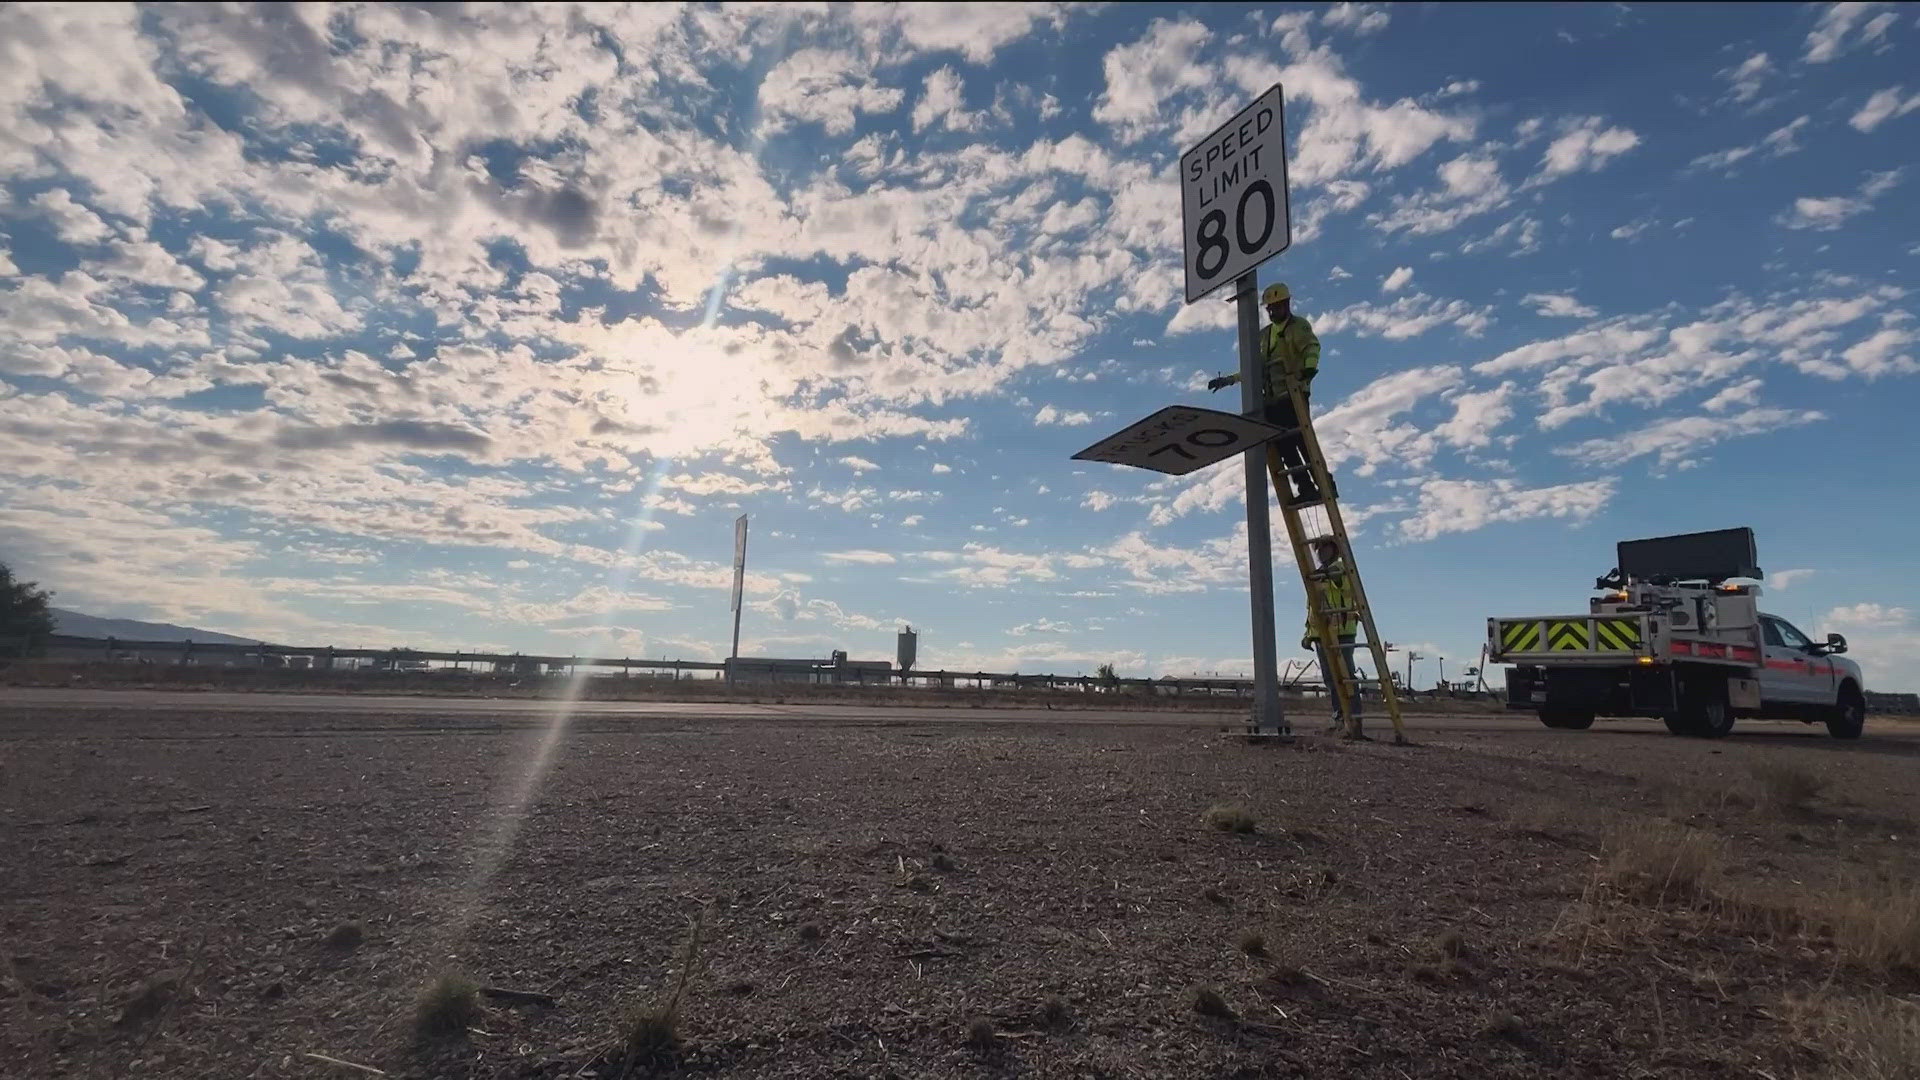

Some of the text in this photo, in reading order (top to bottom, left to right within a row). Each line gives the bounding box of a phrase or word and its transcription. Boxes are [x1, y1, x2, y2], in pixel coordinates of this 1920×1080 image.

[1190, 108, 1273, 182] SPEED
[1200, 144, 1264, 209] LIMIT
[1195, 179, 1275, 280] 80
[1148, 429, 1239, 460] 70
